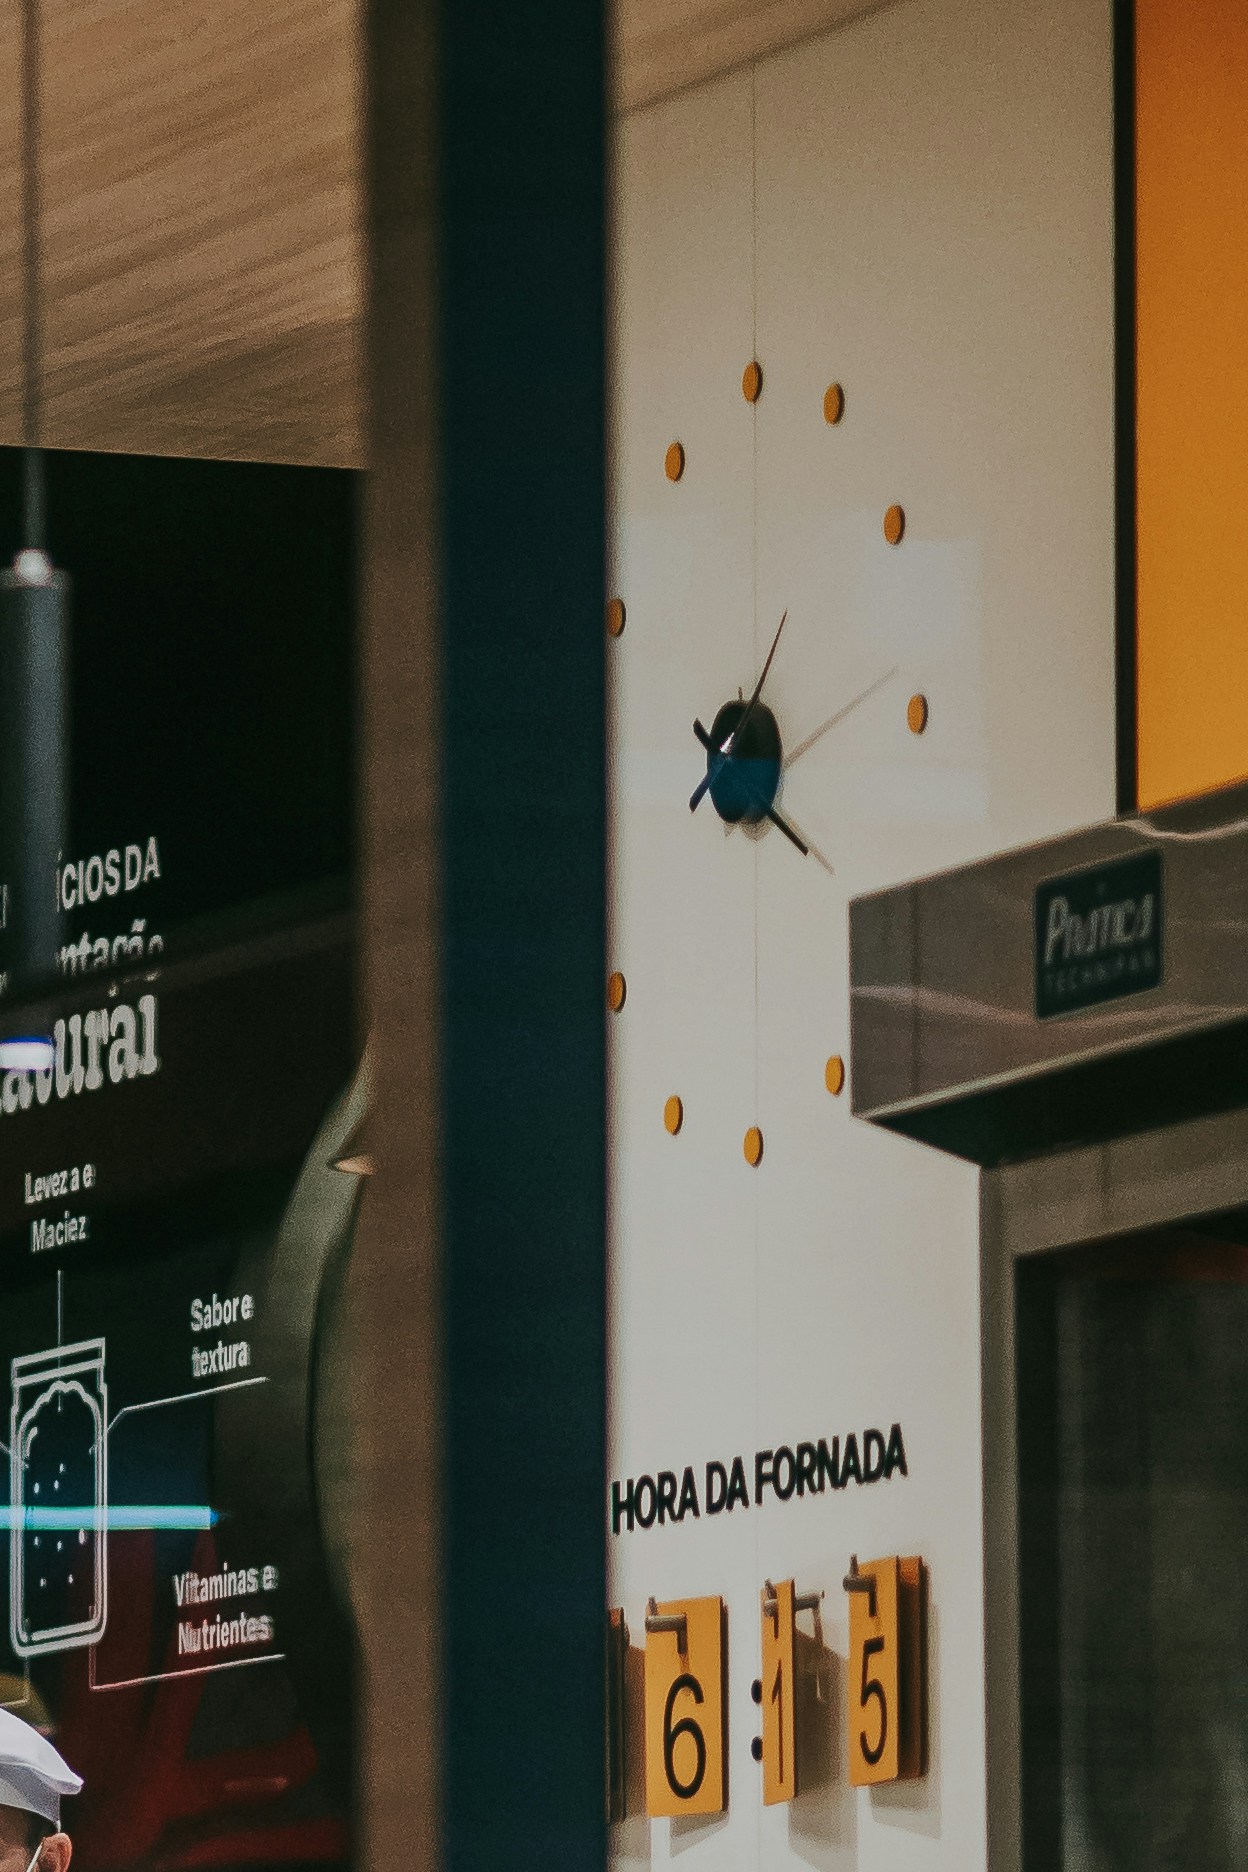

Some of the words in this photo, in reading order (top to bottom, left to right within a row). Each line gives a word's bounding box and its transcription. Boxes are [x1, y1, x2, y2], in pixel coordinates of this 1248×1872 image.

[123, 835, 161, 892] DA
[31, 1210, 88, 1253] Maciez
[191, 1292, 240, 1331] Sabor
[240, 1294, 255, 1320] e
[192, 1340, 251, 1378] textura
[611, 1465, 701, 1536] HORA
[705, 1456, 750, 1515] DA
[754, 1423, 909, 1506] FORNADA
[173, 1561, 259, 1607] Vitaminas
[261, 1565, 278, 1591] e
[178, 1611, 274, 1655] Nutrientes
